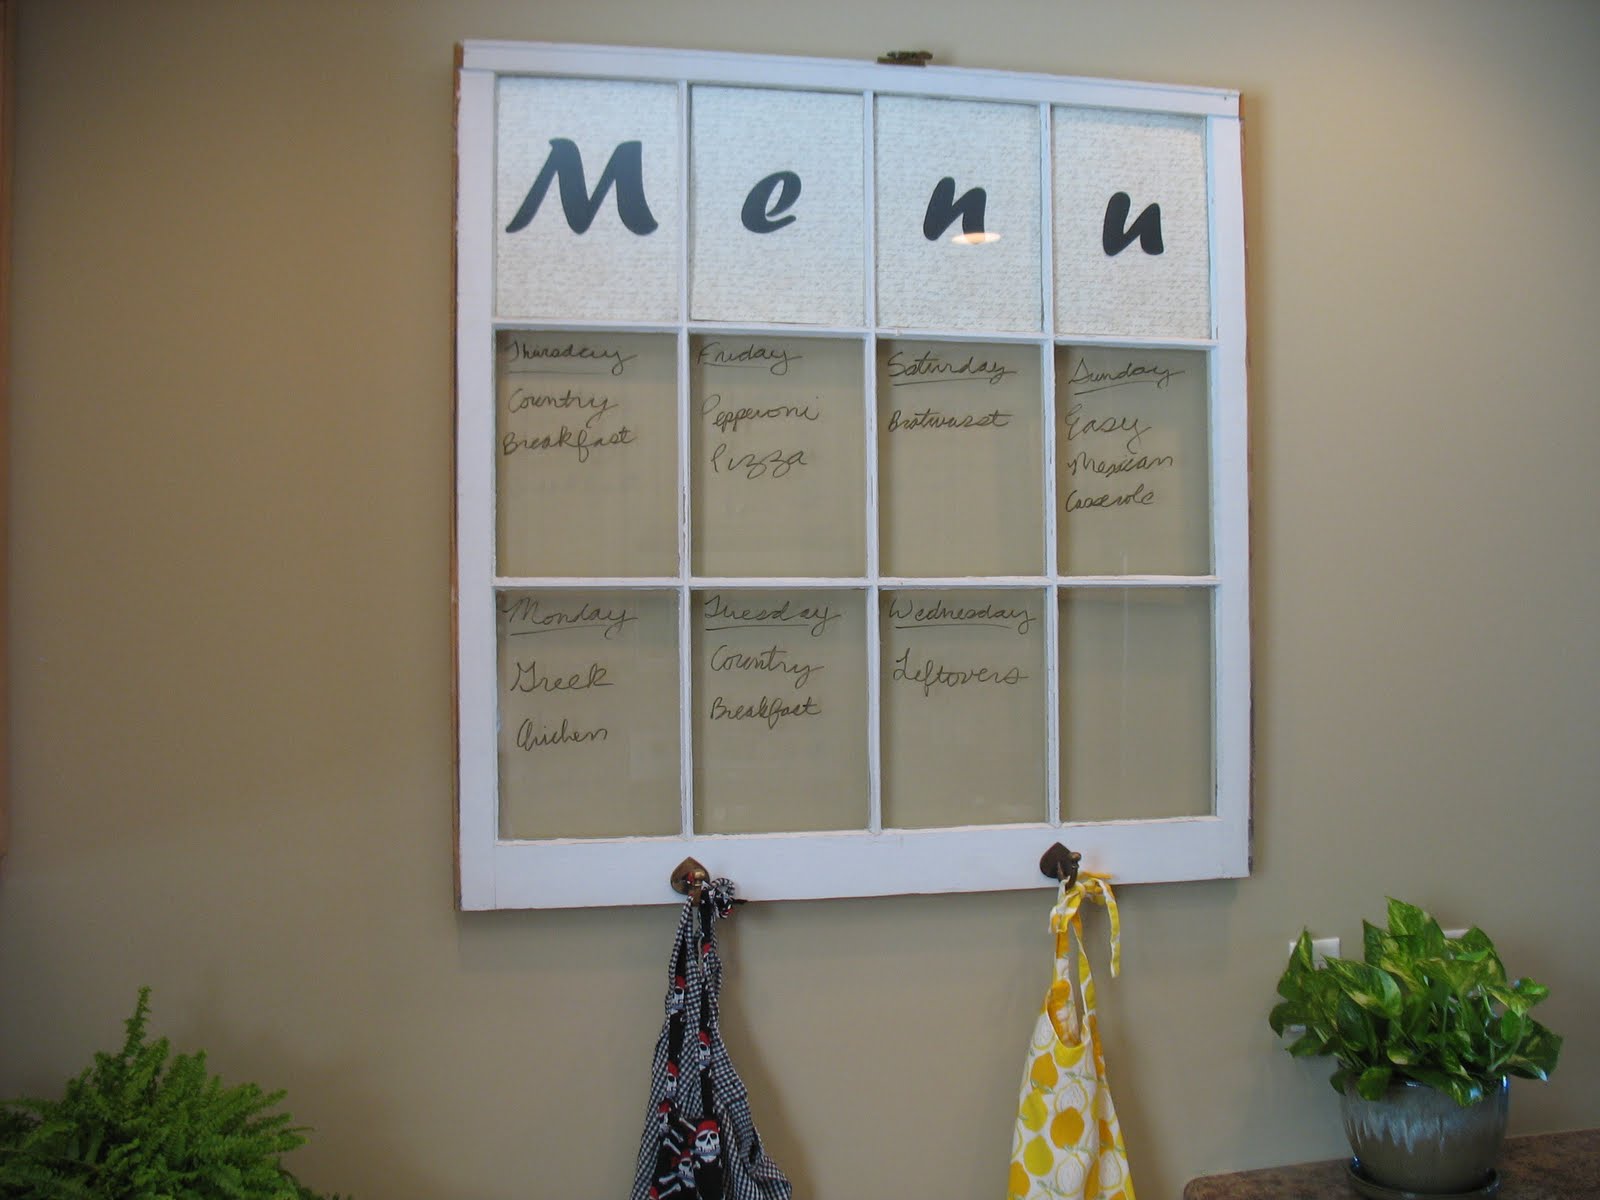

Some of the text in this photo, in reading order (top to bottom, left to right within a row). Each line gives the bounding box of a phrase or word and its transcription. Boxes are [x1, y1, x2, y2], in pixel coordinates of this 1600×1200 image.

[698, 343, 802, 375] Friday
[888, 350, 1017, 384] Saturday
[1068, 358, 1185, 391] Sunday
[508, 388, 620, 429] Country
[702, 394, 819, 429] Pepperoni
[503, 424, 638, 463] Breakfast
[1064, 404, 1152, 450] Easy
[711, 445, 808, 480] Pizza
[1067, 452, 1174, 478] Mexican
[503, 596, 638, 640] Monday
[704, 595, 842, 637] Tuesday
[889, 599, 1037, 634] Wednesday
[510, 661, 614, 692] Greek
[711, 645, 825, 689] Country
[892, 648, 1029, 697] Leftovers
[710, 696, 822, 730] Breakfast
